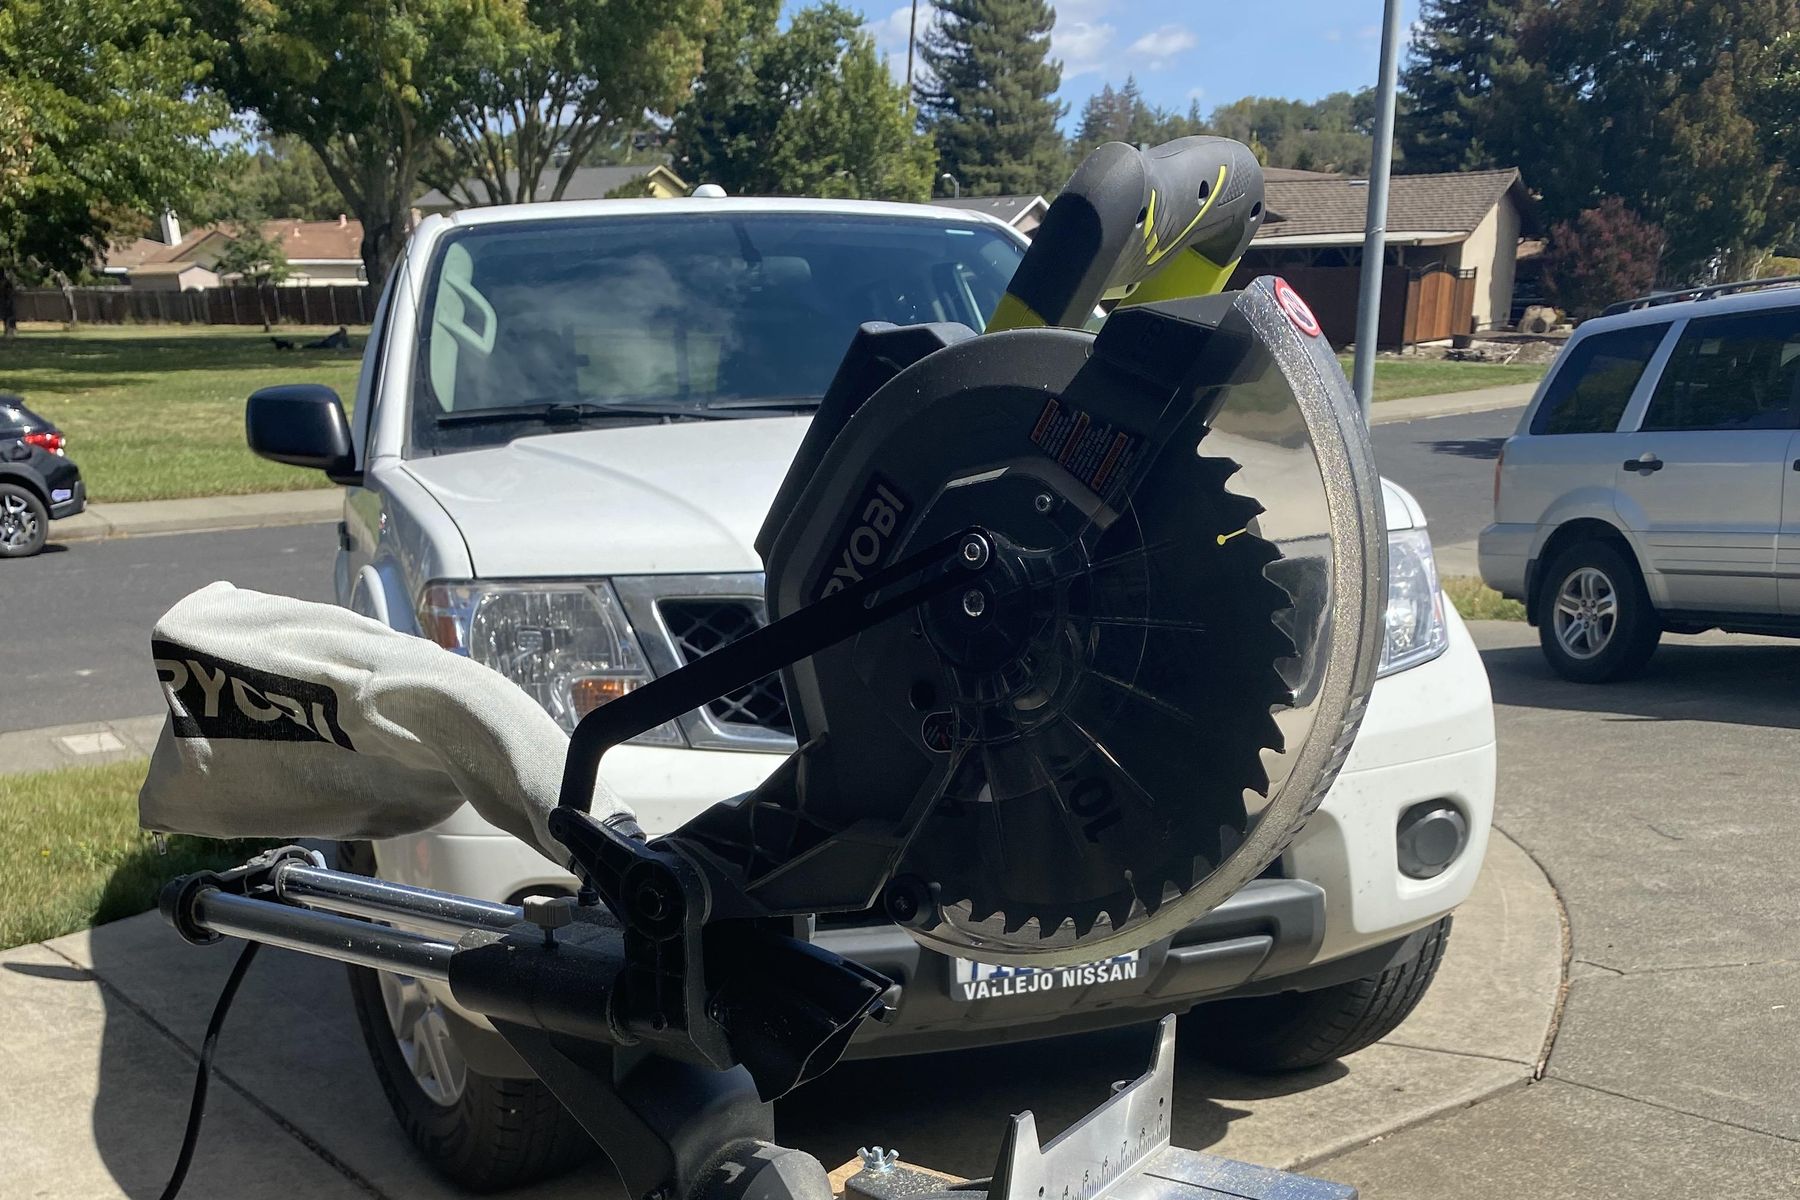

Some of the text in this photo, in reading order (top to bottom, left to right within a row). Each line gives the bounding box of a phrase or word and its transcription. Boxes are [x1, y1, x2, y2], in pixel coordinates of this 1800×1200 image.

[964, 972, 1053, 1001] VALLEJO
[1062, 961, 1138, 988] NISSAN
[1084, 1169, 1089, 1182] 5
